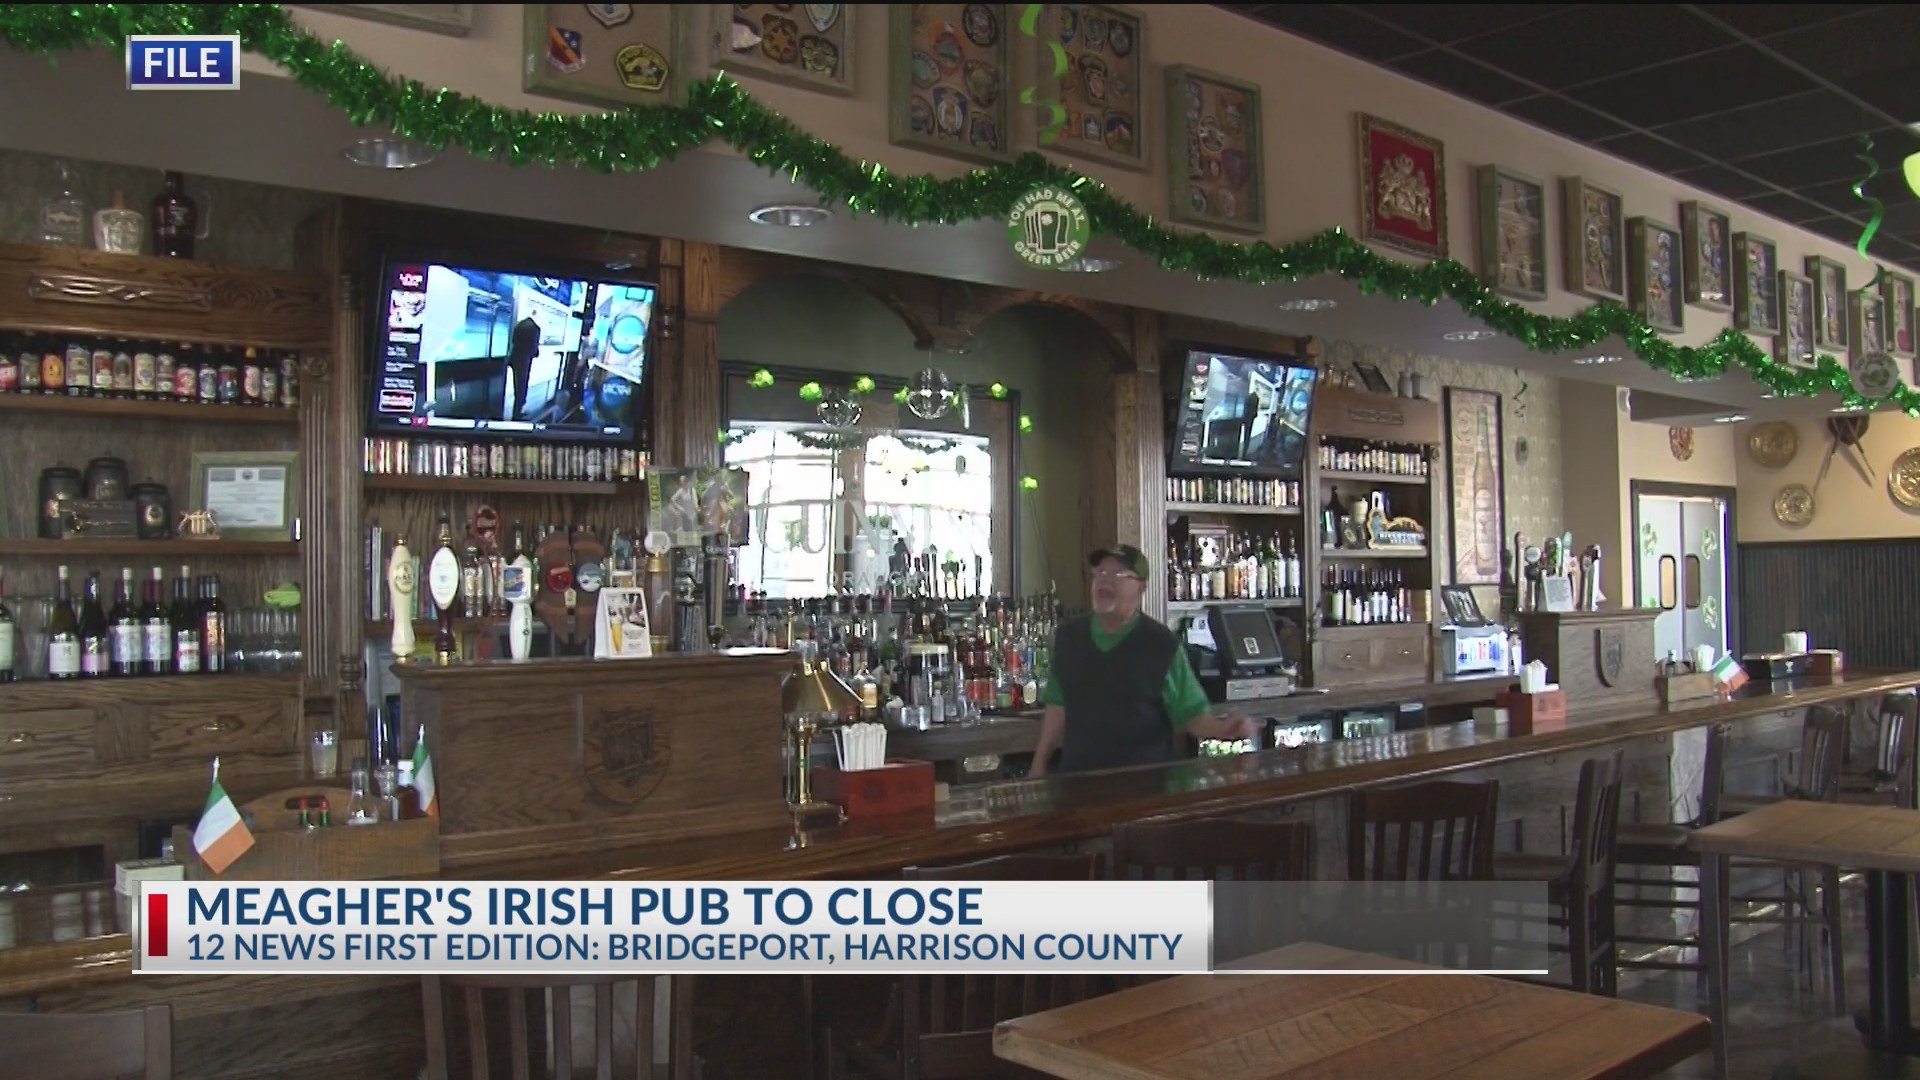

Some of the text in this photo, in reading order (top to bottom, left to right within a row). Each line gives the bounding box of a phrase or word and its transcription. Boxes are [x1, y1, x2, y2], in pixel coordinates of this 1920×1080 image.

[1008, 202, 1026, 228] YOU
[1025, 188, 1053, 204] HAD
[1056, 191, 1074, 208] ME
[1014, 240, 1081, 266] GREEN BEER
